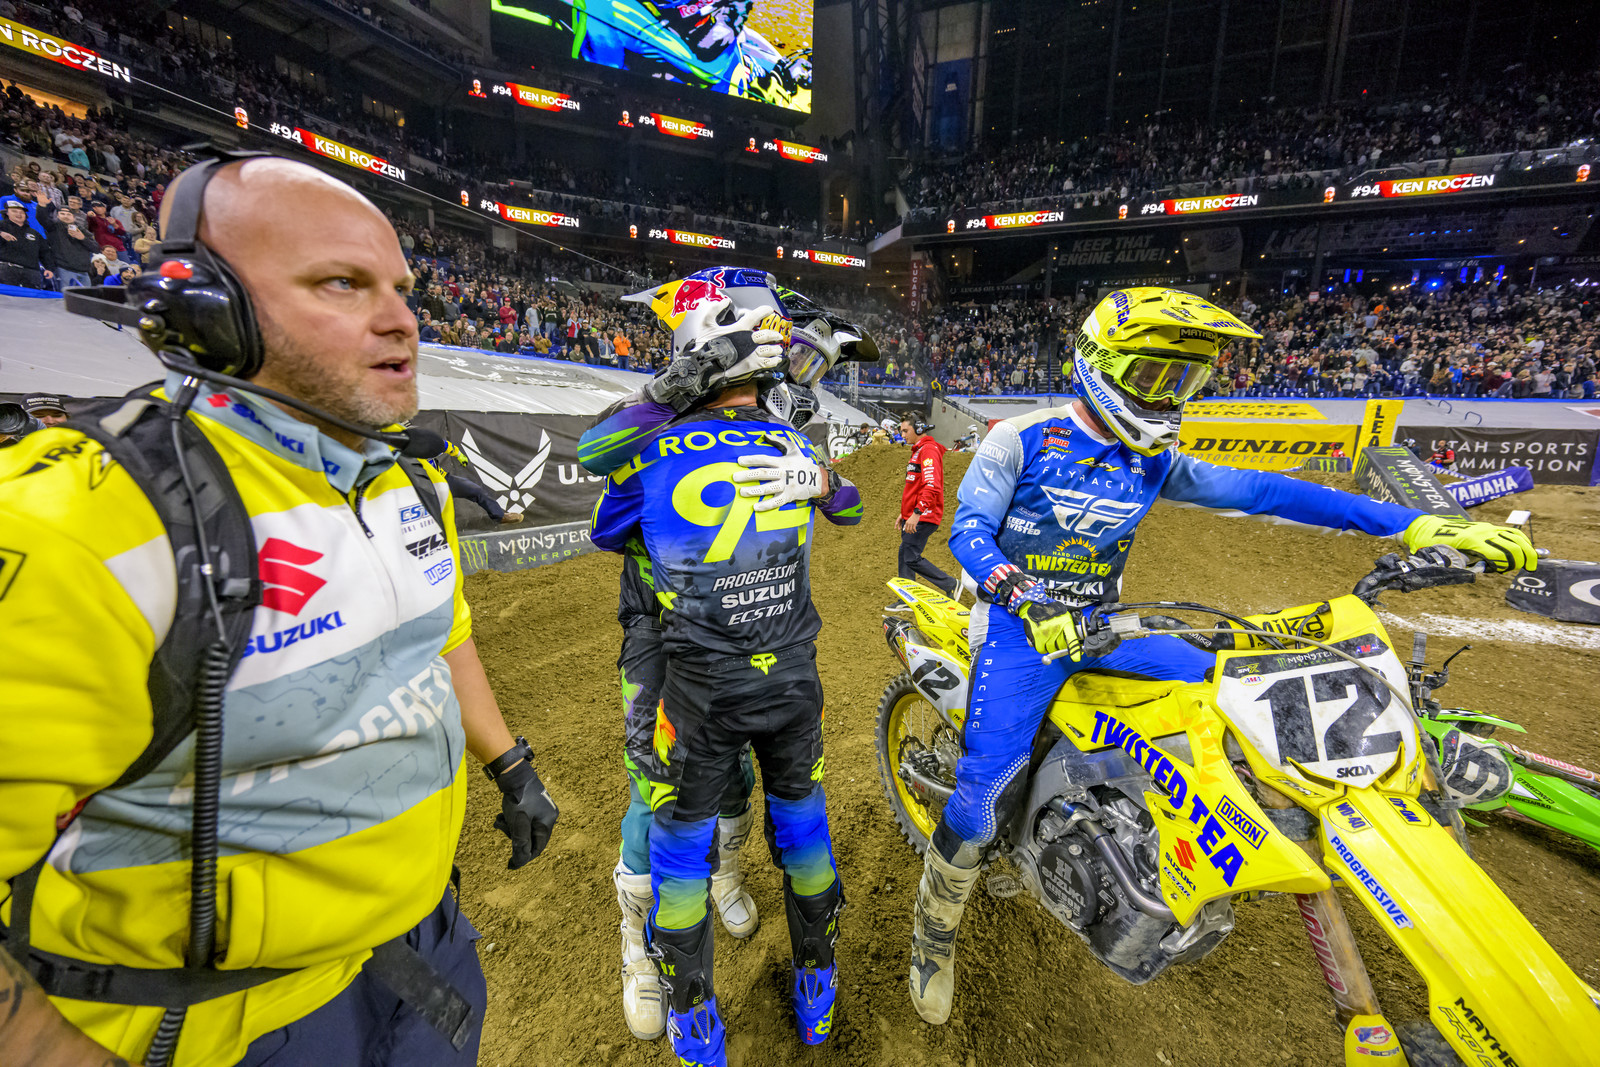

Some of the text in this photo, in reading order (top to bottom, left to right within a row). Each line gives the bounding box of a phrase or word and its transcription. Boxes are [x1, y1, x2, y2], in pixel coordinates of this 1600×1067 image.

[21, 29, 132, 83] ROCZEN
[492, 84, 580, 111] #94 KEN ROCZEN
[638, 115, 713, 138] #94 KEN ROCZEN
[269, 122, 406, 181] #94 KEN ROCZEN
[763, 141, 828, 162] #94 KEN ROCZEN
[1351, 174, 1495, 198] #94 KEN ROCZEN
[480, 199, 580, 228] #94 KEN ROCZEN
[1141, 194, 1258, 214] #94 KEN ROCZEN
[966, 211, 1064, 229] #94 KEN ROCZEN
[649, 229, 736, 249] #94 KEN ROCZEN
[1072, 235, 1154, 253] KEEP THAT
[792, 250, 866, 268] #94 KEN ROCZEN
[1058, 252, 1112, 267] ENGINE
[911, 259, 921, 298] LUCAS
[1077, 357, 1123, 417] PROGRESSIVE
[659, 429, 808, 457] ROCZEN
[1190, 437, 1345, 456] DUNLOP
[1499, 440, 1588, 456] SPORTS
[1187, 453, 1275, 465] MOTORCYCLE
[1460, 456, 1584, 473] MMISSION
[785, 469, 817, 487] FOX
[1396, 459, 1451, 509] MONSTER
[1447, 475, 1519, 502] YAMAHA
[1006, 522, 1041, 536] TWISTED
[1007, 515, 1037, 529] KEEP IT
[498, 528, 591, 556] MONSTER
[1052, 550, 1071, 558] HARD
[516, 547, 582, 565] ENERGY
[1025, 554, 1090, 575] TWISTED
[712, 560, 800, 592] PROGRESSIVE
[721, 578, 796, 609] SUZUKI
[1510, 583, 1553, 597] OAKLEY
[727, 598, 795, 626] ECSTAR
[915, 603, 936, 624] DUNLOP
[242, 611, 347, 659] SUZUKI
[913, 658, 961, 701] 12
[972, 658, 993, 729] RACING
[1254, 665, 1405, 767] 12
[1091, 710, 1188, 810] TWISTED
[1189, 793, 1245, 888] TEA
[1221, 801, 1262, 843] DIXXON
[1335, 801, 1367, 829] WD-40
[1164, 851, 1197, 892] SUZUKI
[1330, 835, 1409, 927] PROGRESSIVE
[1041, 866, 1086, 907] SUZUKI
